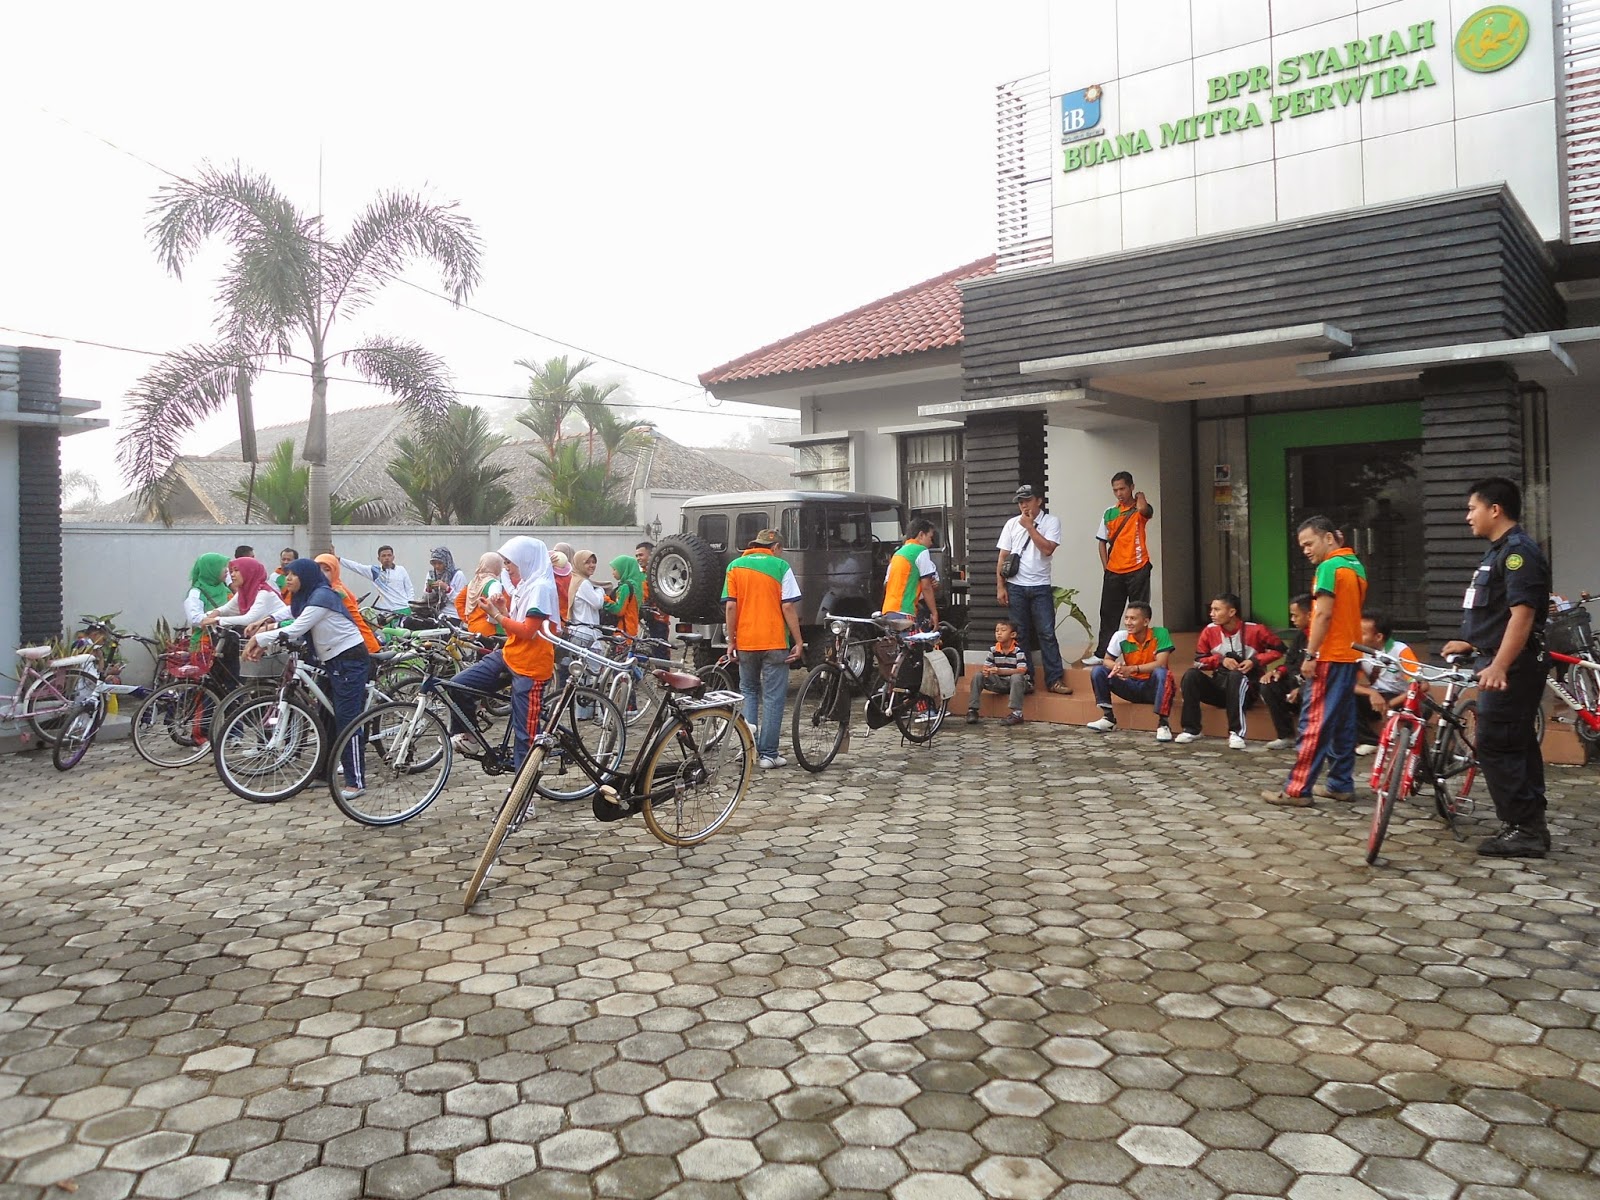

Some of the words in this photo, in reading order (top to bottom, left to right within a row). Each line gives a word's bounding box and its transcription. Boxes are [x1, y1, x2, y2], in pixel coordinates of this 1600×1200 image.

[1207, 68, 1270, 102] BPR
[1278, 21, 1435, 84] SYARIAH
[1063, 131, 1152, 171] BUANA
[1159, 107, 1262, 147] MITRA
[1269, 60, 1435, 122] PERWIRA
[1063, 108, 1085, 133] iB
